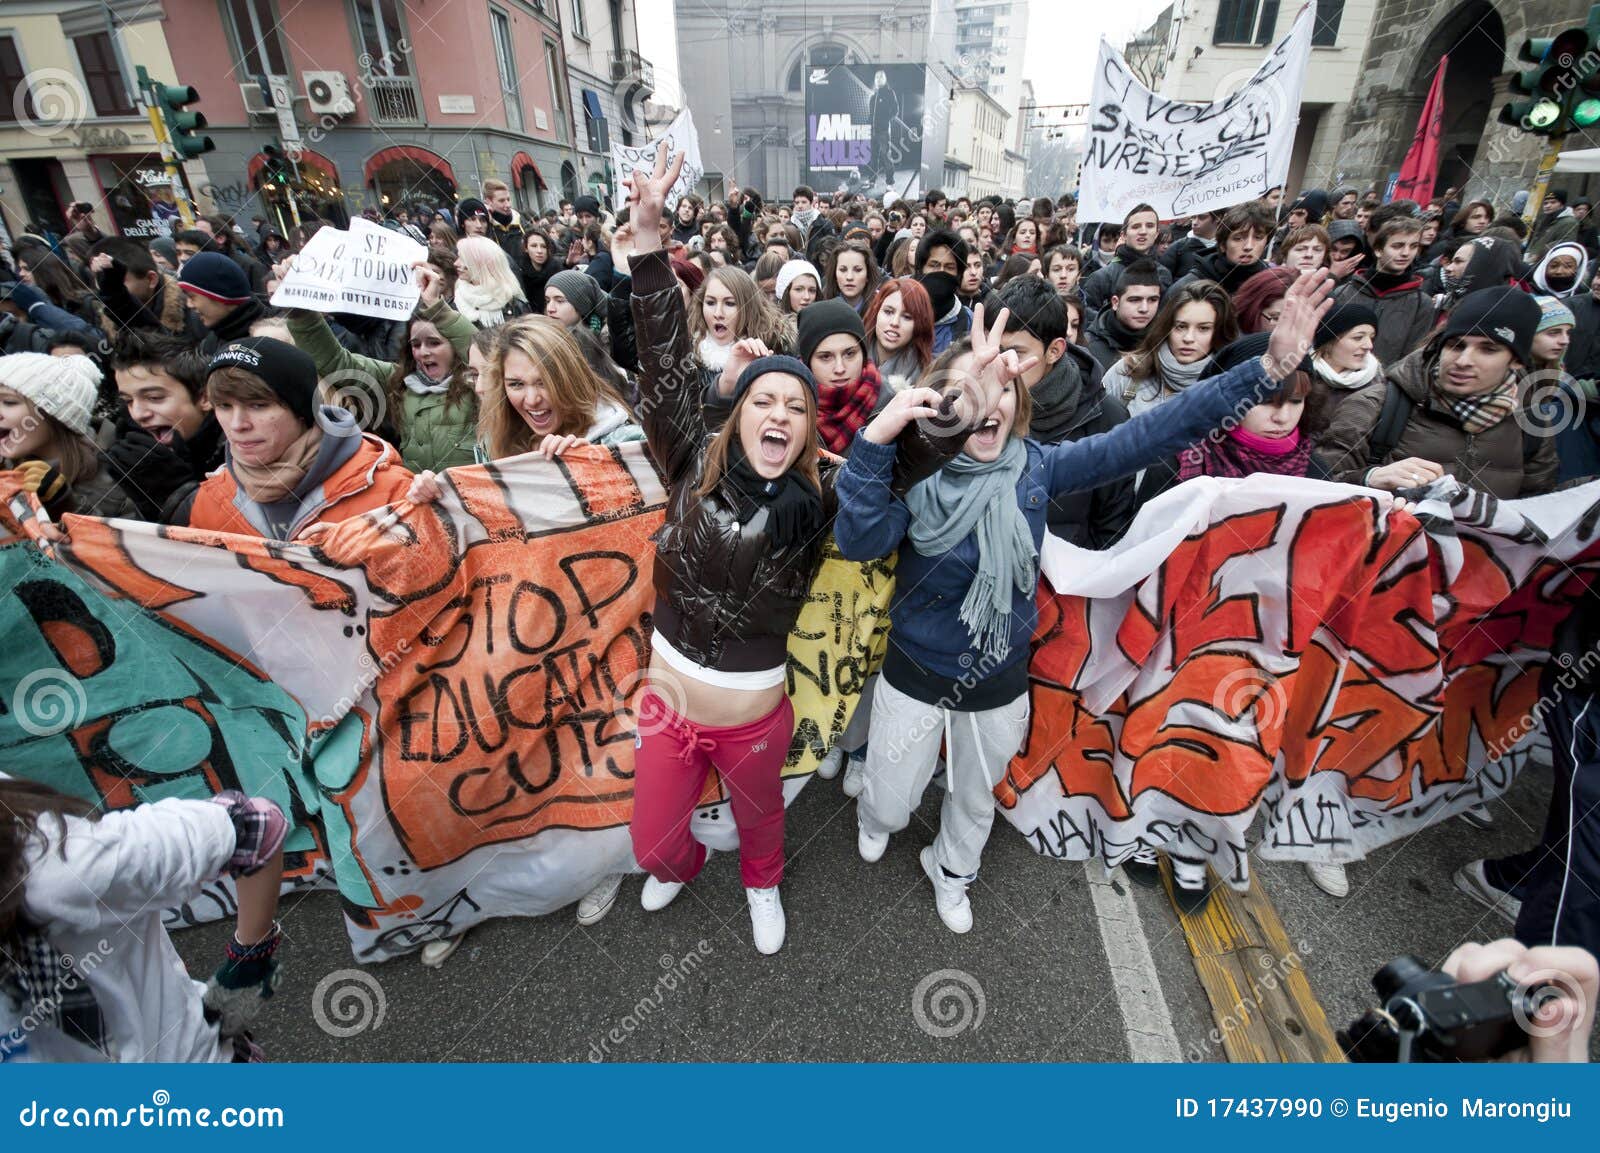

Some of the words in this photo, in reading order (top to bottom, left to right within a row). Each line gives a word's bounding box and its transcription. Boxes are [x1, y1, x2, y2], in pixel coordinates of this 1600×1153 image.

[816, 113, 851, 140] AM
[809, 140, 872, 166] RULES
[364, 233, 387, 256] SE
[341, 291, 371, 305] TUTTI
[374, 297, 382, 307] A
[415, 550, 638, 675] STOP
